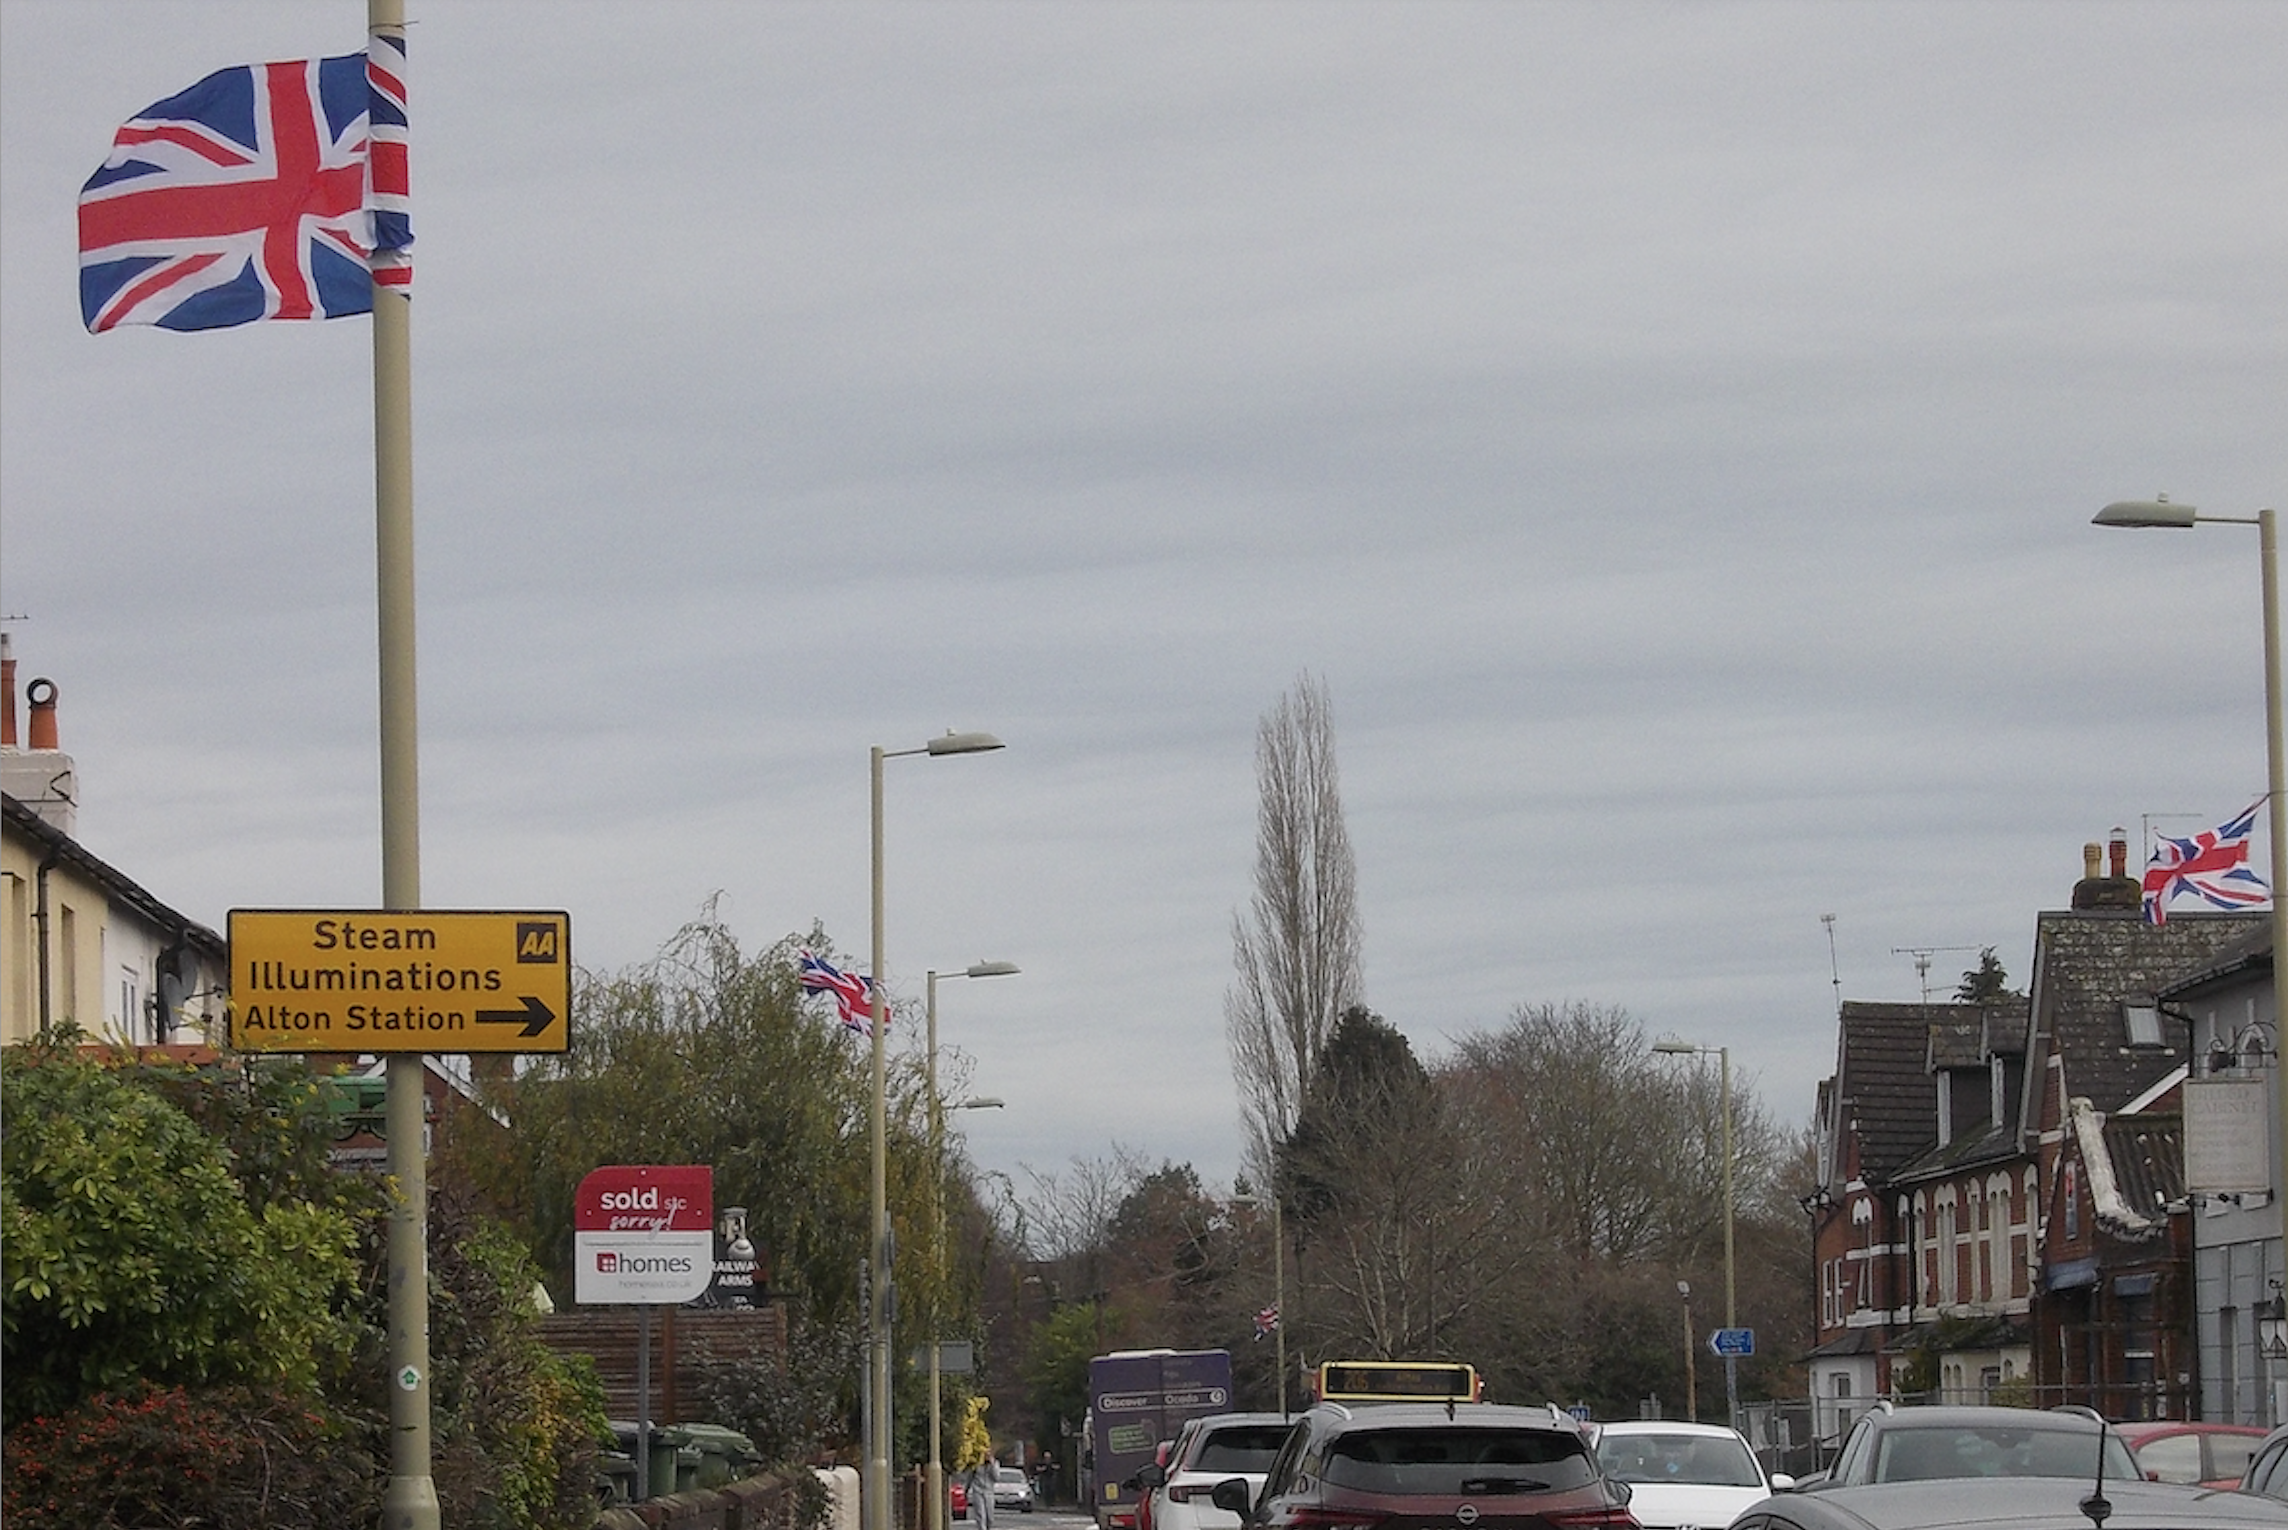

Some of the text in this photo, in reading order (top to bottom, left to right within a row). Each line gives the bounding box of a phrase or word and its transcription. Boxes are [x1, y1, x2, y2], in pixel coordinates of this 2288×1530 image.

[313, 920, 436, 950] Steam
[520, 931, 554, 957] AA
[250, 961, 502, 991] Illuminations
[243, 1006, 465, 1031] Alton Station
[600, 1186, 659, 1211] sold
[619, 1252, 692, 1273] homes
[717, 1274, 754, 1286] ARMS
[1102, 1397, 1148, 1408] Discover
